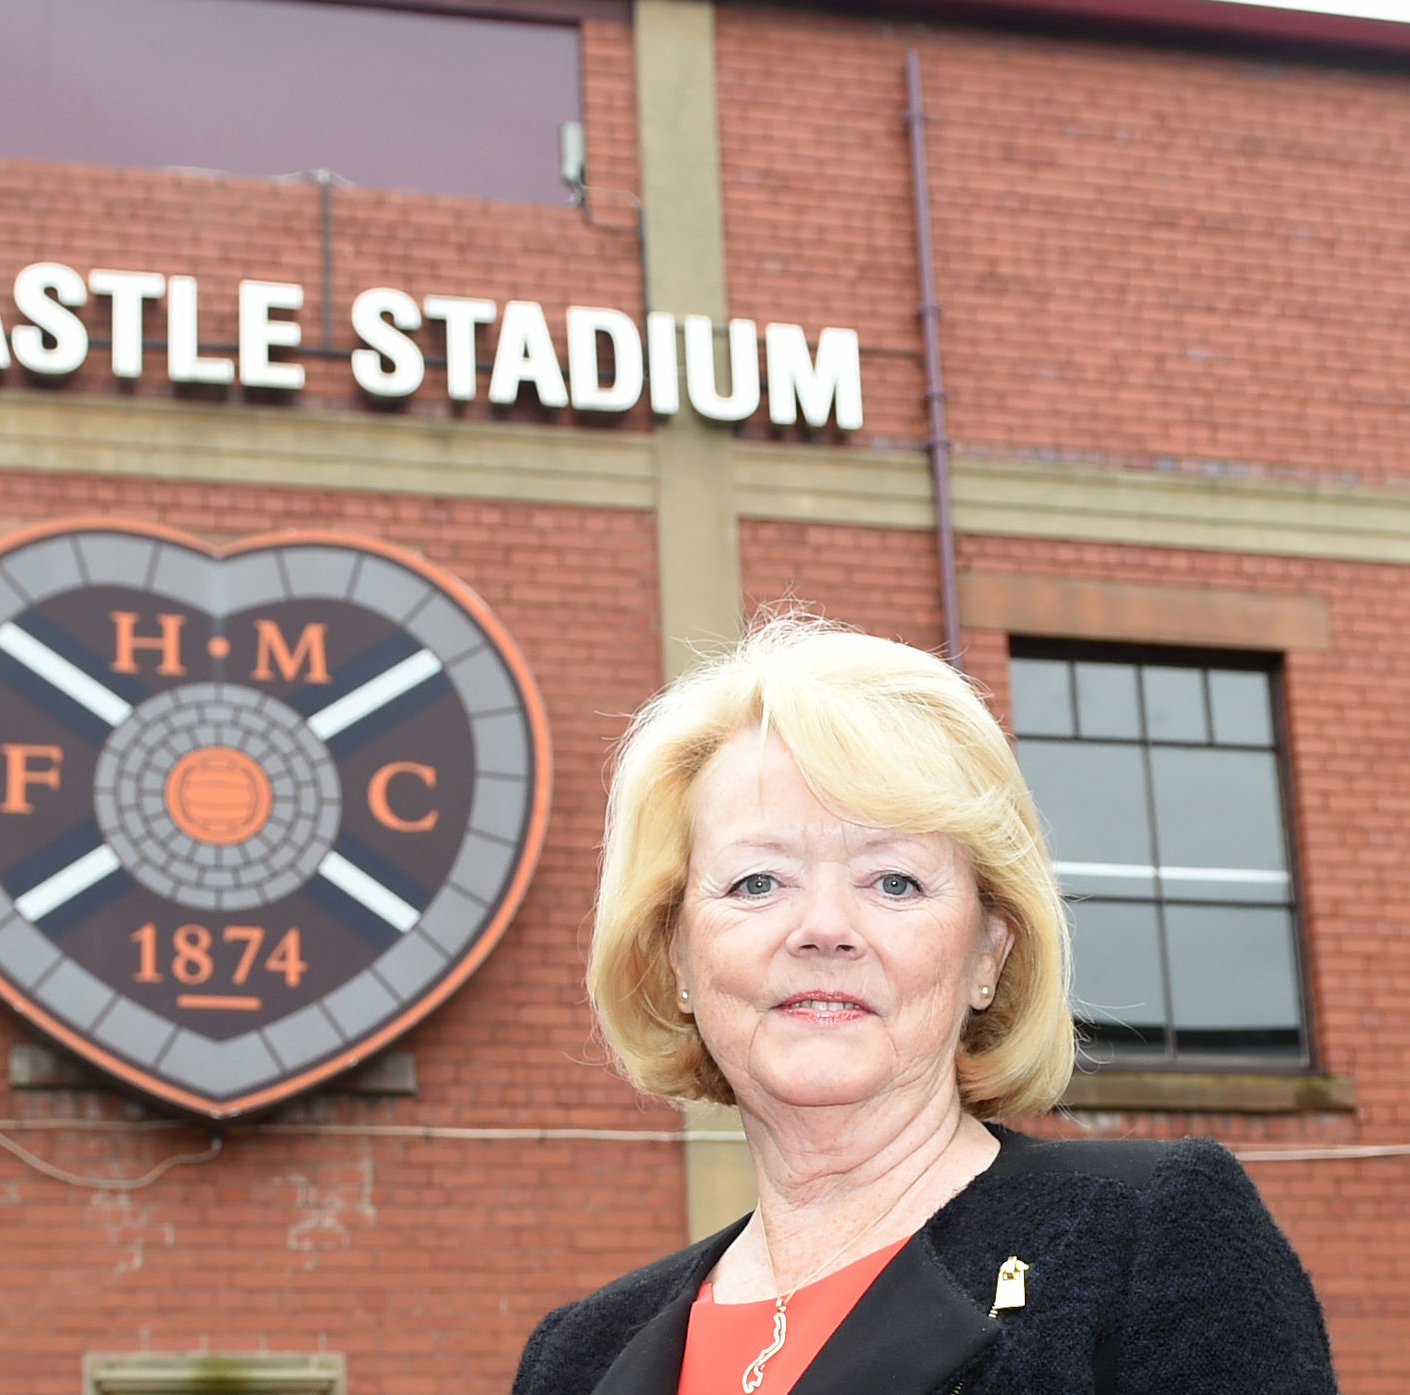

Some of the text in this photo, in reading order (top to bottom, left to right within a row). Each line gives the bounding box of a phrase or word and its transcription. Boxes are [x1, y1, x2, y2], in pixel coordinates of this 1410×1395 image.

[351, 287, 864, 432] STADIUM
[109, 611, 334, 685] H M
[366, 761, 440, 833] C
[130, 922, 308, 988] 1874
